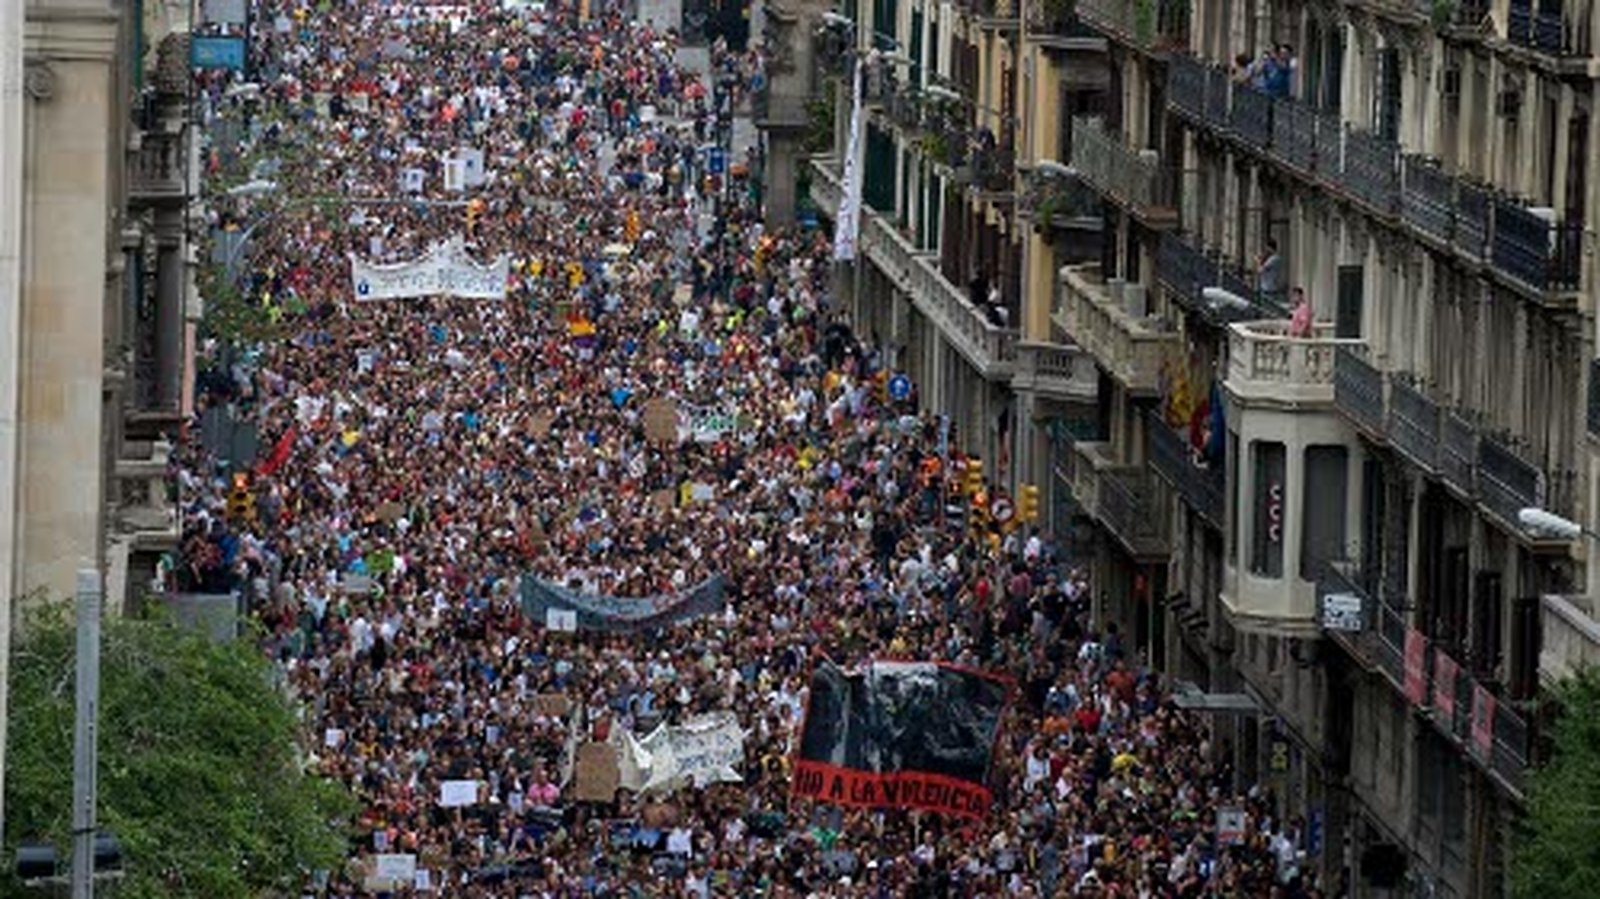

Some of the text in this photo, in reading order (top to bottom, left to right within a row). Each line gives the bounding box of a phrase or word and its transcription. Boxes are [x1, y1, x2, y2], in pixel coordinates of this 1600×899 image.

[794, 769, 985, 815] NO A LA VIOLENCIA
